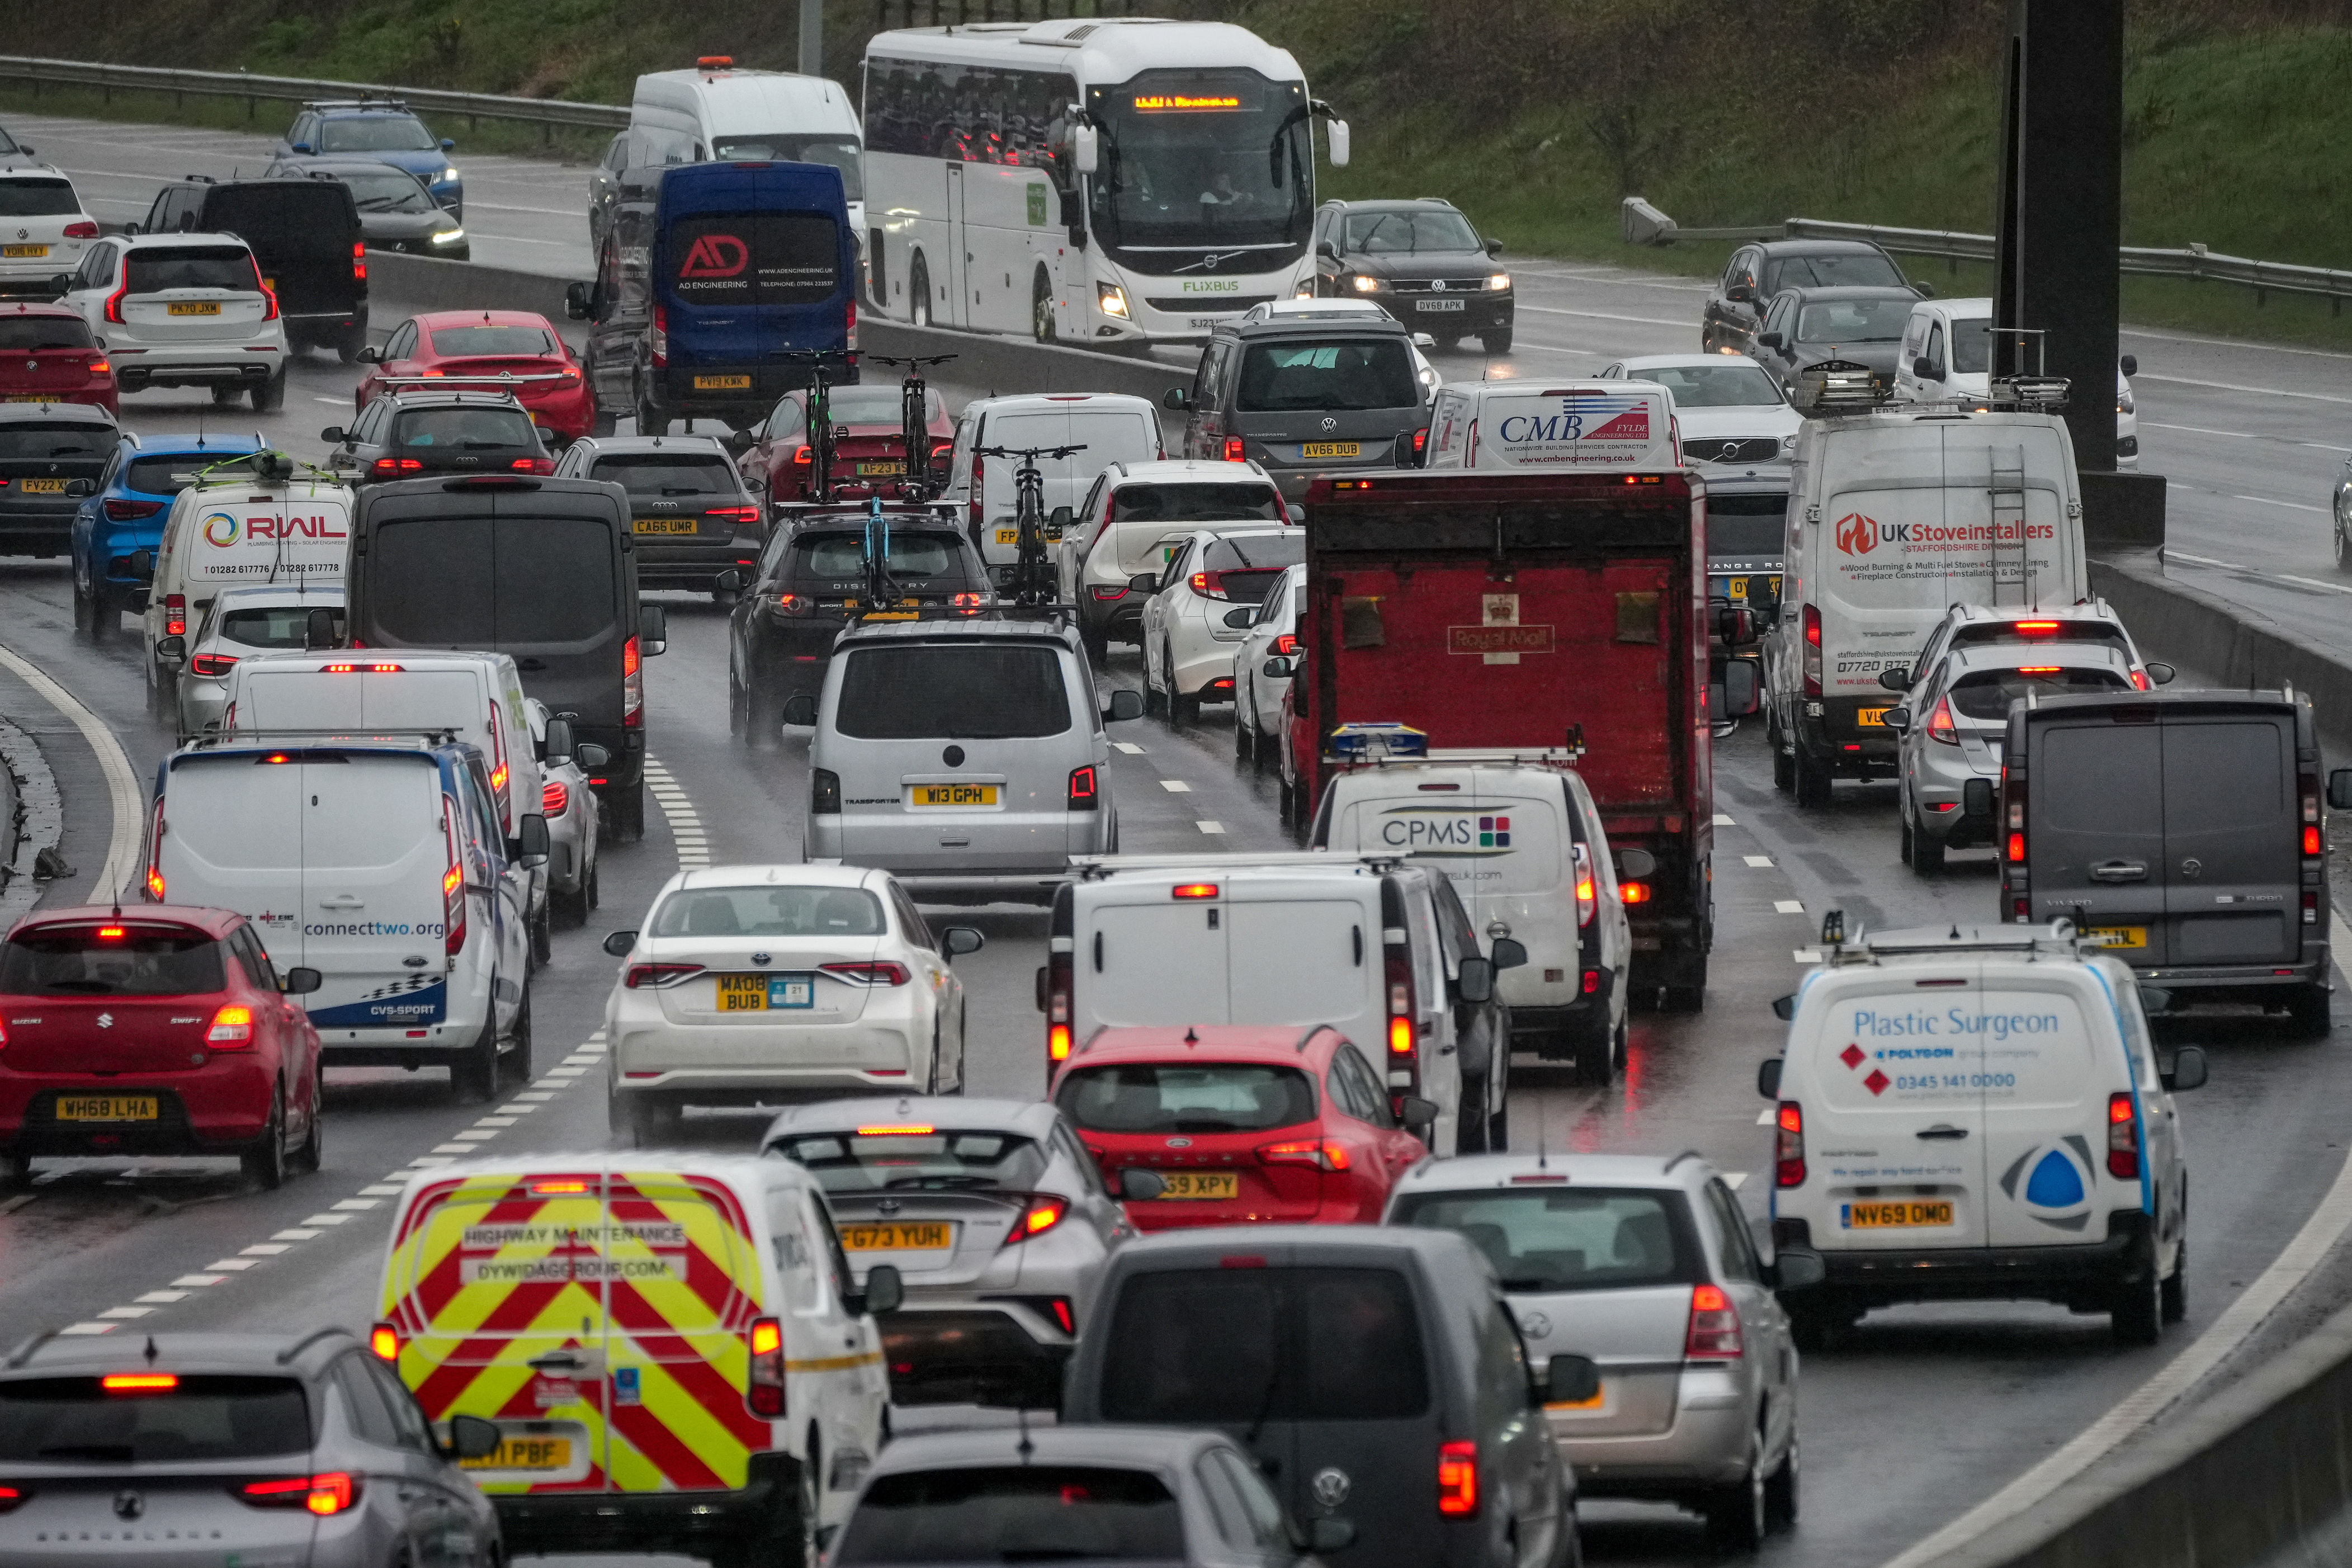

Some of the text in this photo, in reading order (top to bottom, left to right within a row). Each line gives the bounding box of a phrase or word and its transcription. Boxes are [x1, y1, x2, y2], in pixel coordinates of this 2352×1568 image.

[171, 304, 196, 313] PK70
[1445, 302, 1461, 310] APK
[1500, 415, 1583, 442] CMB
[1306, 445, 1357, 455] AV66 DUB
[1519, 454, 1635, 464] www.cmbengineering.co.uk
[863, 464, 891, 474] AF23
[27, 480, 54, 490] FV22
[638, 522, 692, 532] CA66 UMR
[1906, 544, 1979, 552] STAFFORDSHIRE
[239, 565, 270, 573] 617776
[281, 564, 306, 573] 01282
[1872, 563, 1904, 572] Burning
[1858, 572, 1893, 581] Fireplace
[2010, 569, 2038, 578] Desgn
[1456, 629, 1547, 650] Royal Mail
[1838, 650, 1924, 659] staffordshire@ukstoveinstalle
[1838, 660, 1881, 672] 07720
[1837, 677, 1879, 686] www.uksto
[928, 788, 983, 802] W13 GPH
[1383, 819, 1471, 846] CPMS
[305, 922, 444, 939] connecttwo.org
[727, 994, 760, 1009] BUB
[1855, 1008, 2058, 1041] Plastic Surgeon
[1897, 1073, 2015, 1089] 0345 141 0000
[116, 1099, 149, 1116] LHA
[1196, 1175, 1232, 1194] XPY
[1855, 1203, 1905, 1225] NV69
[464, 1226, 682, 1243] HIGHWAY MAINTENANCE
[842, 1227, 894, 1248] FG73
[512, 1442, 556, 1465] PBF
